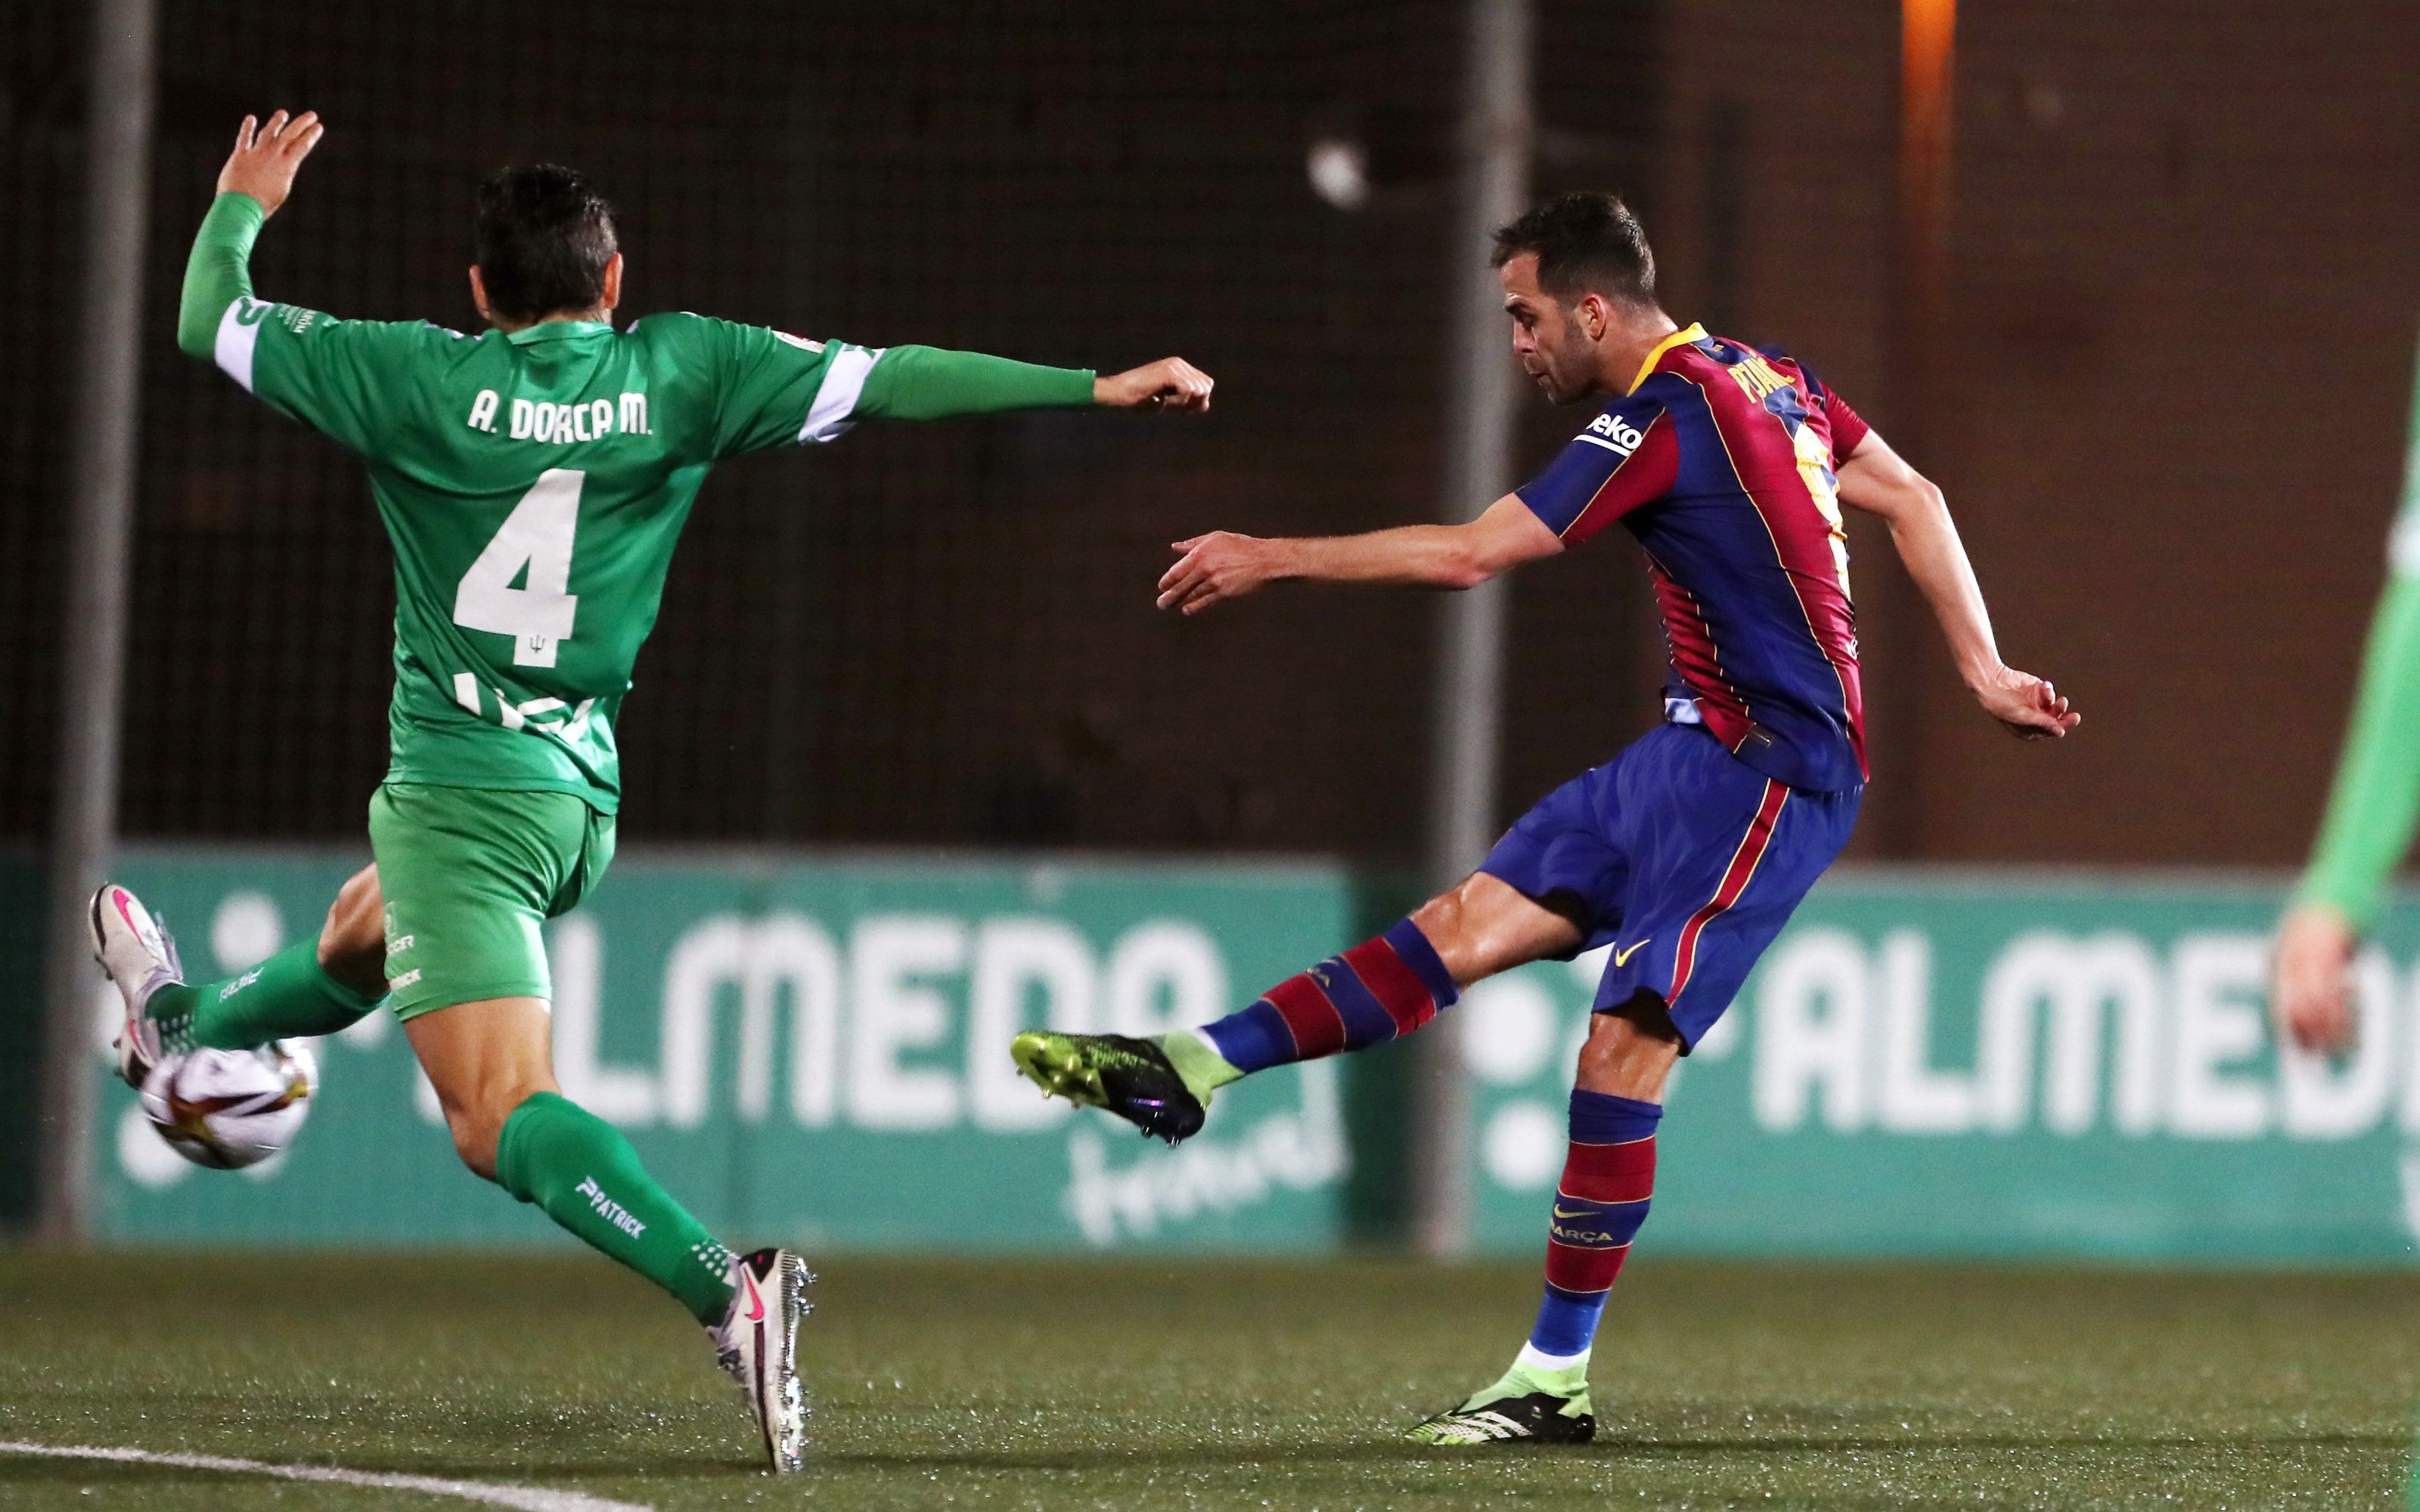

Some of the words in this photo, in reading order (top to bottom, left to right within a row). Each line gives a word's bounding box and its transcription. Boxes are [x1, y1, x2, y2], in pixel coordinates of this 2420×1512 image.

[467, 389, 498, 434] A.
[509, 398, 614, 445] DORCA
[1585, 413, 1643, 450] eko
[454, 467, 585, 668] 4
[418, 911, 1229, 1134] LMEDA
[1748, 924, 2420, 1142] ALMED
[590, 1191, 647, 1240] PATRICK
